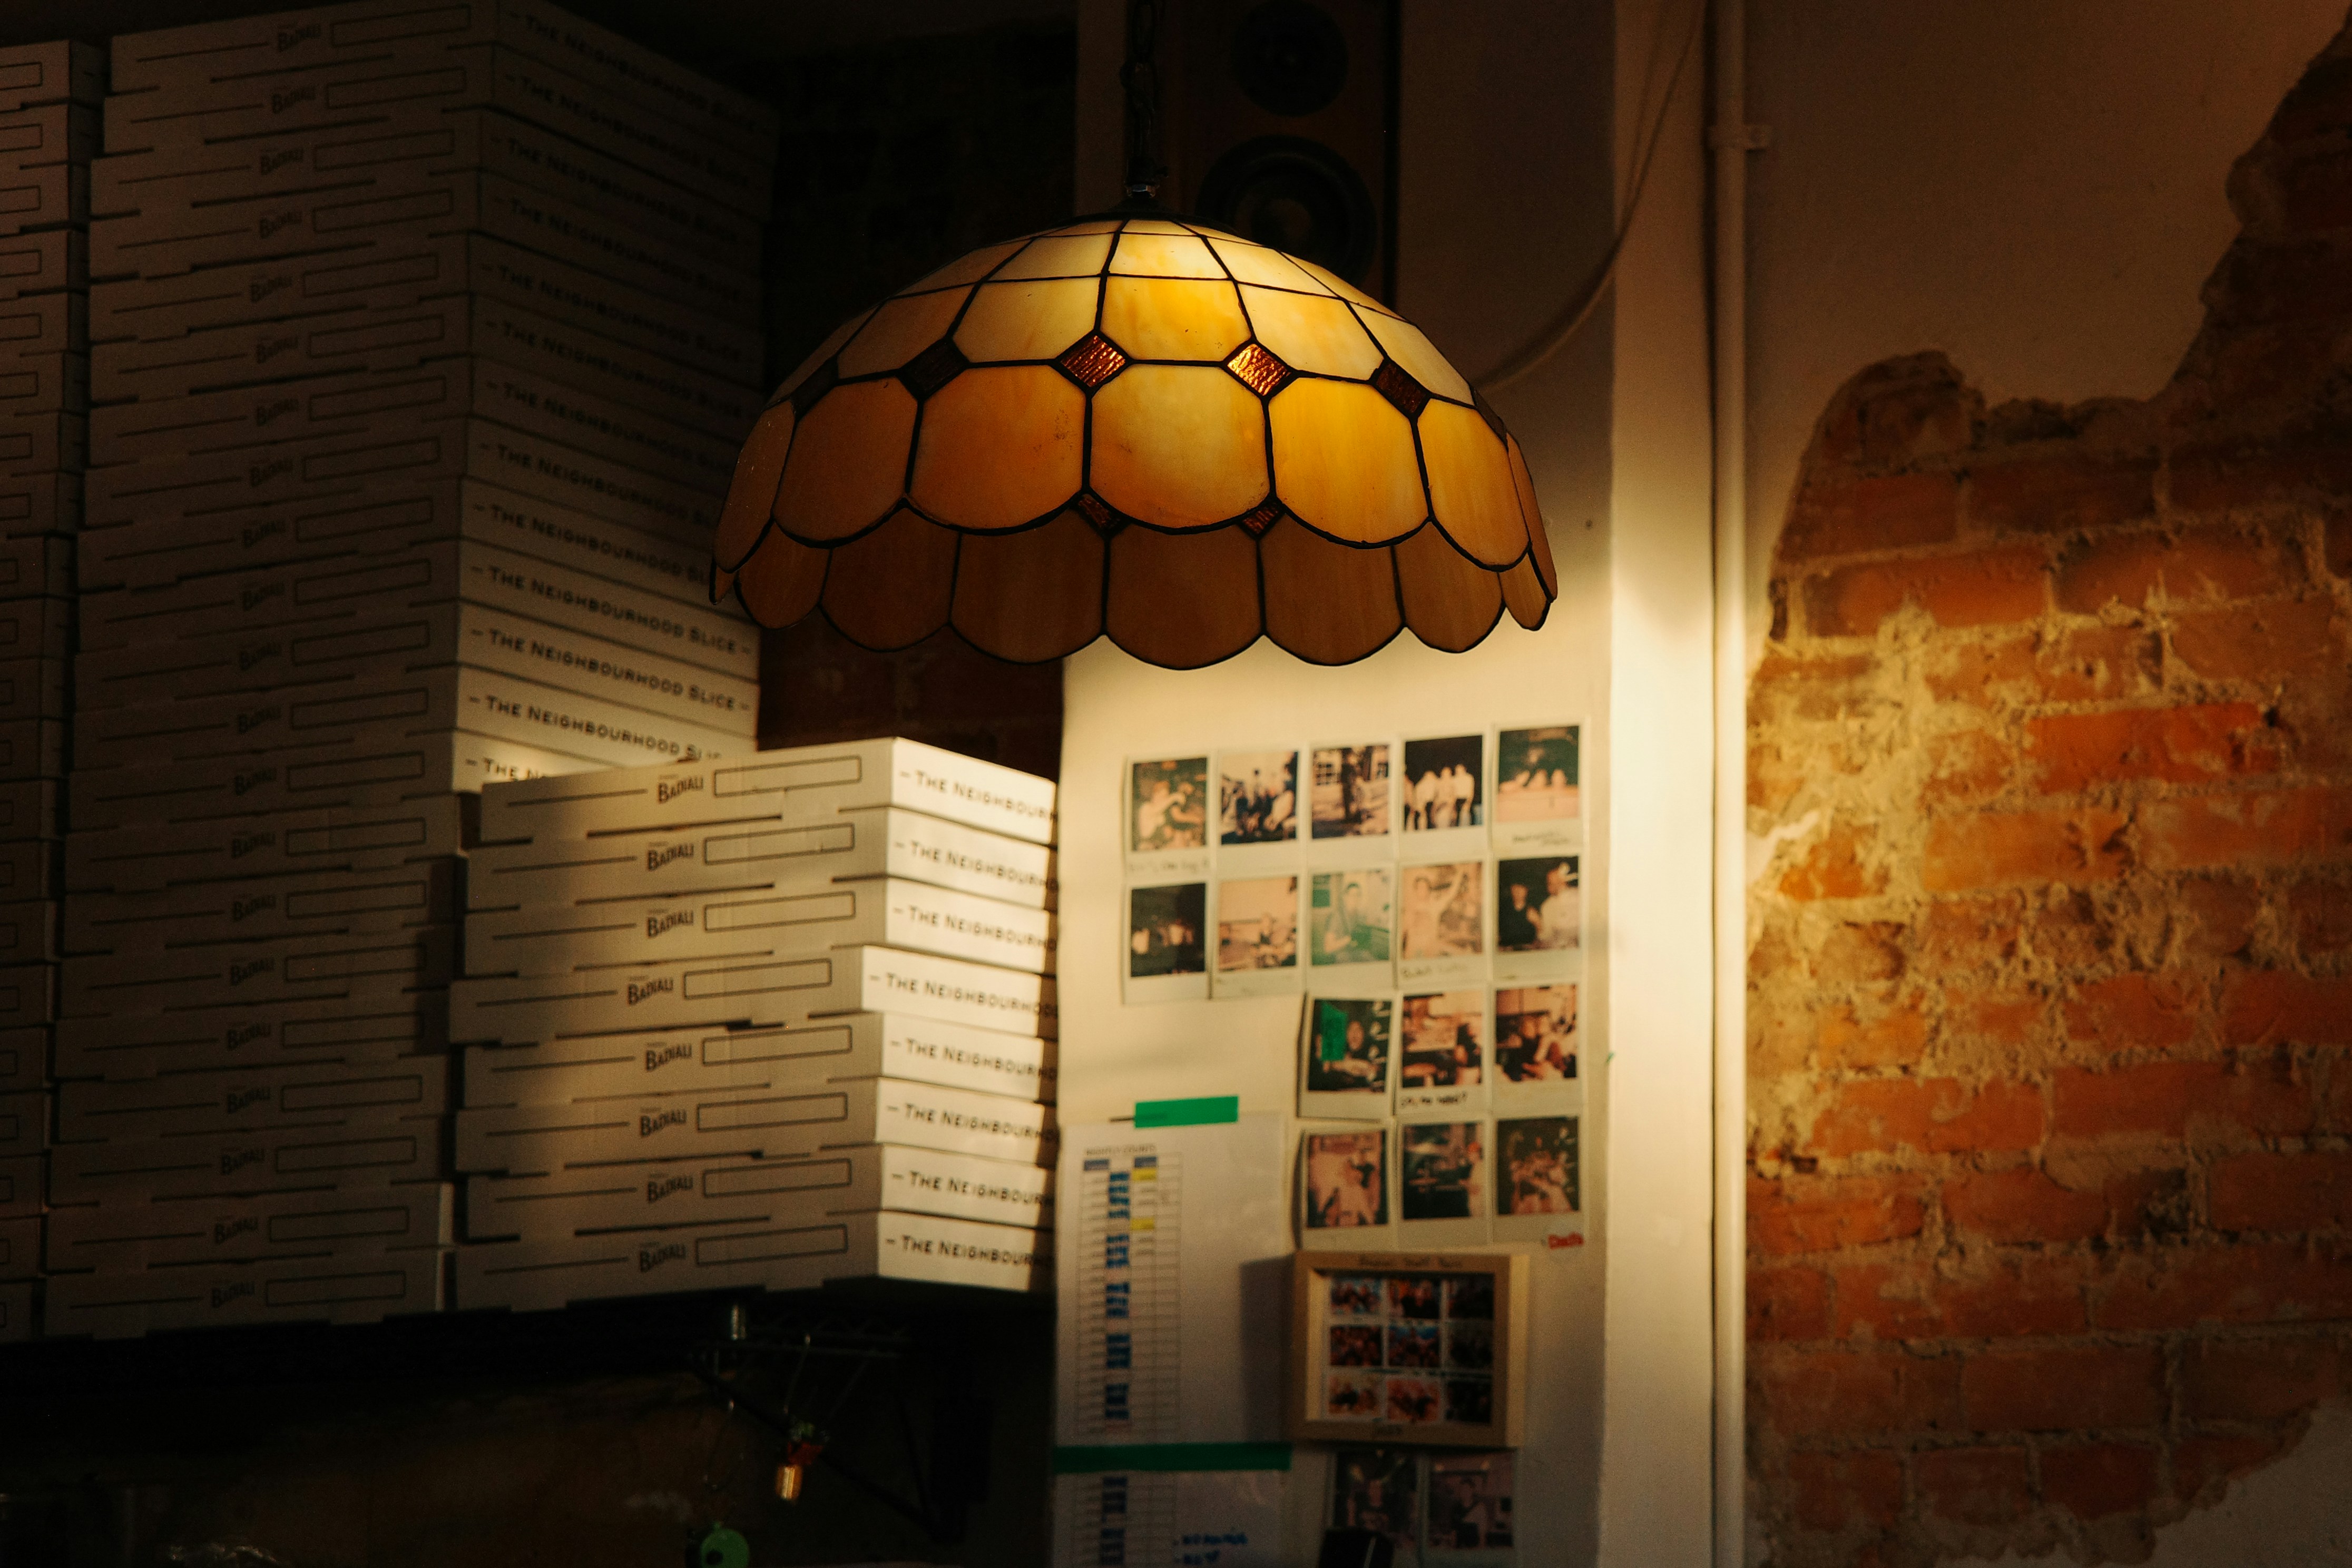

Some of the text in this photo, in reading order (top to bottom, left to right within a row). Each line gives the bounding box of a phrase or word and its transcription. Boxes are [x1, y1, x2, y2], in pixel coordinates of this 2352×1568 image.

[491, 504, 525, 527] THE
[488, 565, 737, 654] THE NEIGHBOURHOOD SLICE
[488, 628, 735, 711] THE NEIGHBOURHOOD SLICE
[486, 694, 522, 718] THE
[527, 706, 680, 756] NEIGHBOURHOOD
[915, 770, 946, 792] THE
[911, 841, 939, 861] THE
[909, 905, 937, 926] THE
[886, 972, 918, 994] THE
[906, 1037, 936, 1059] THE
[905, 1103, 935, 1123] THE
[910, 1171, 940, 1190] THE
[902, 1235, 932, 1255] THE
